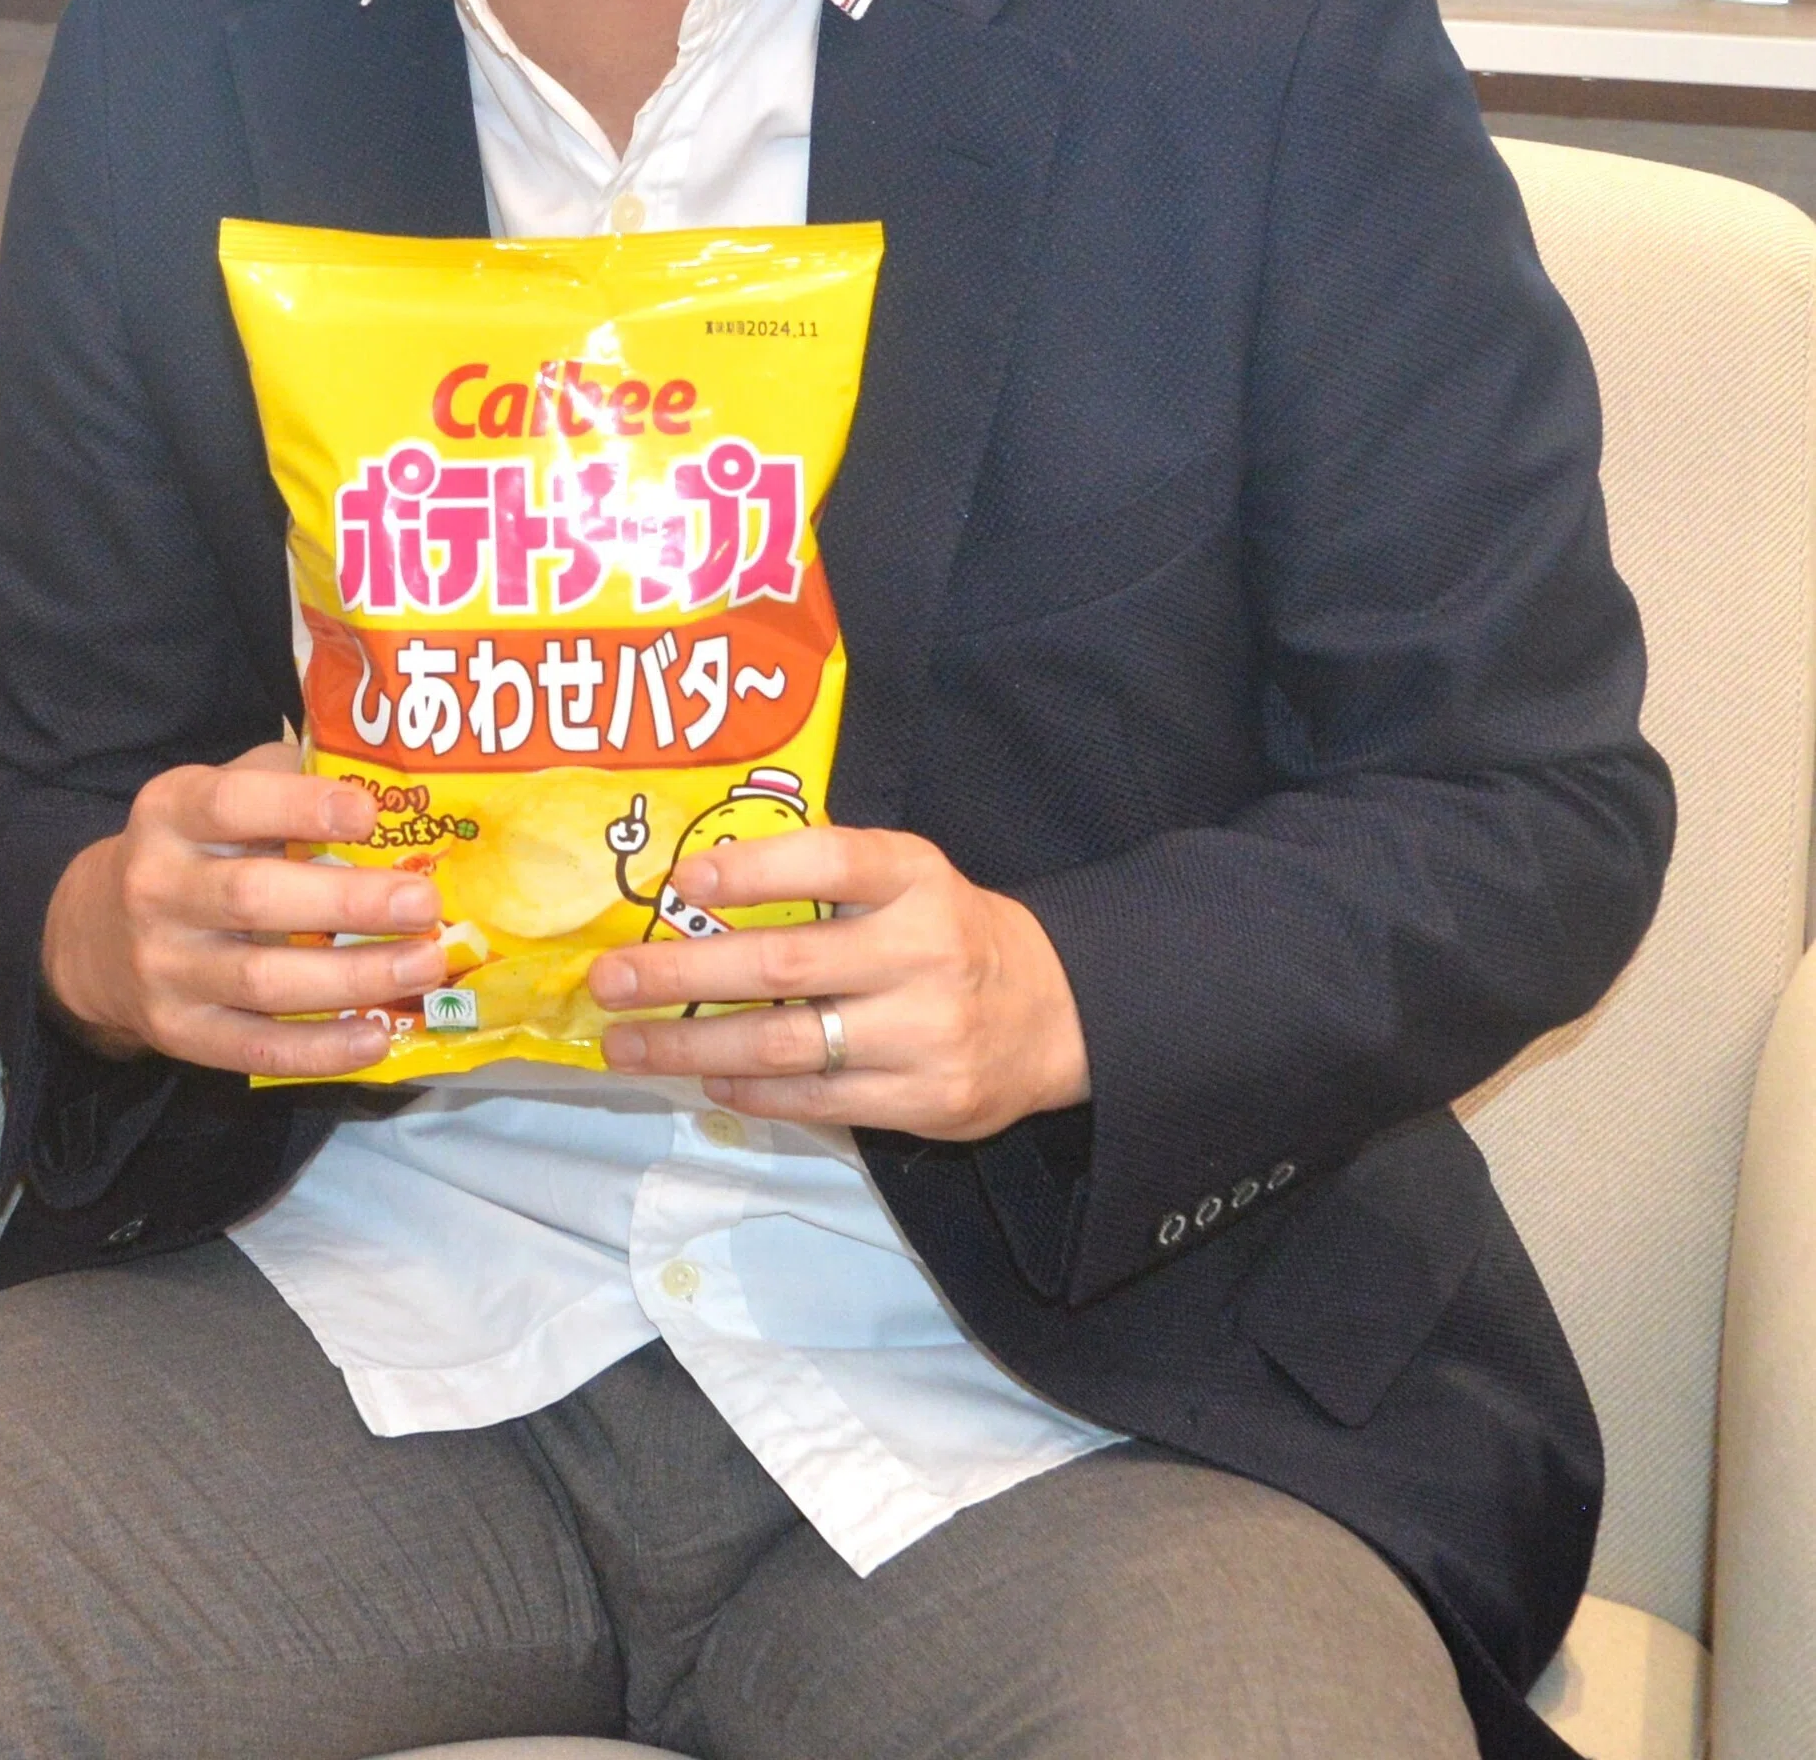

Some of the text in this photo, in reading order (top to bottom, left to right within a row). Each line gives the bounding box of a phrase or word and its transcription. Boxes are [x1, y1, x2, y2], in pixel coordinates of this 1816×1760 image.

[432, 358, 697, 440] Calbee
[335, 440, 805, 612] ポテトチップス
[350, 633, 788, 756] しあわせバタ〜
[664, 895, 722, 935] PO
